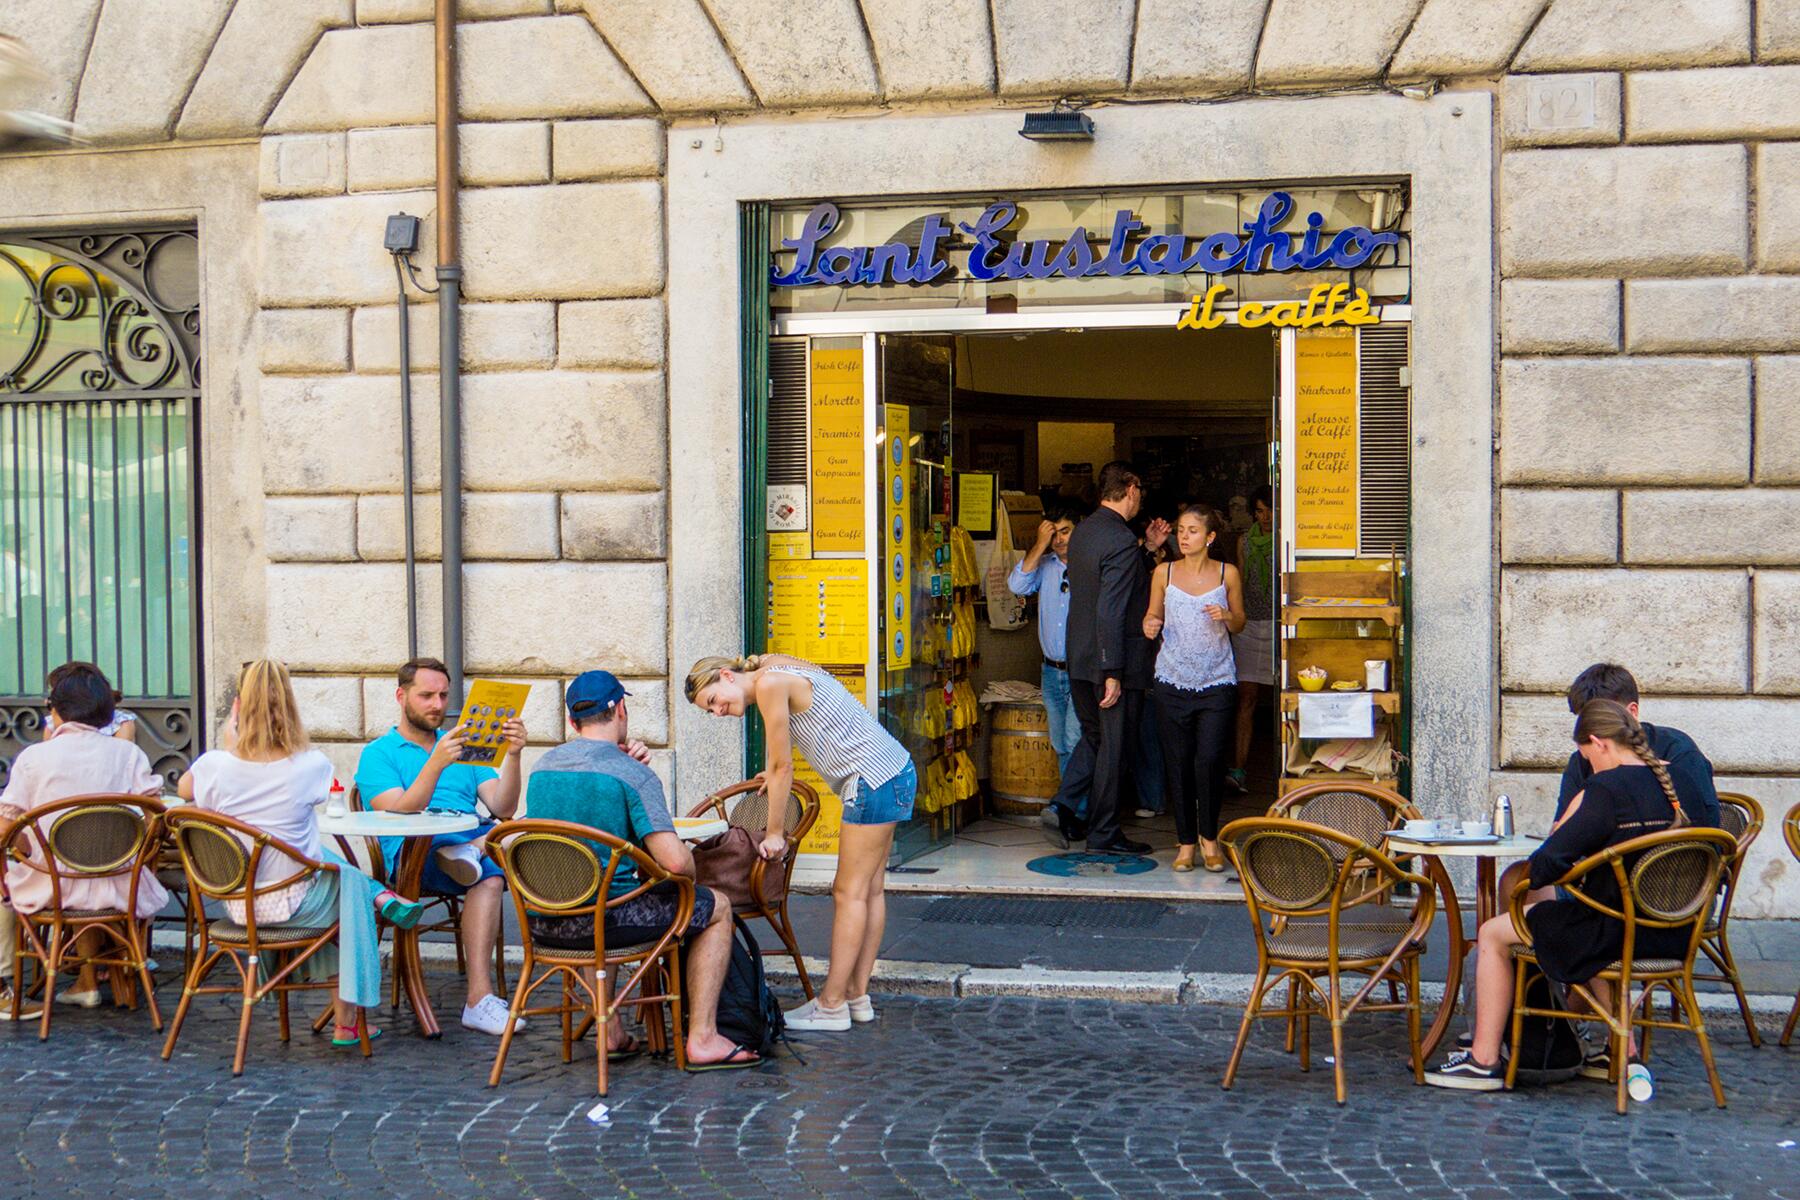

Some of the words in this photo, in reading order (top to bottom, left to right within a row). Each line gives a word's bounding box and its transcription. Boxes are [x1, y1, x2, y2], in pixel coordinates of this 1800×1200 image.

[769, 202, 951, 286] Sant
[958, 191, 1400, 281] Eustachio
[1176, 283, 1227, 330] il
[1238, 282, 1380, 328] caffè
[814, 393, 861, 406] Moretto
[1301, 412, 1350, 424] Mousse
[1300, 425, 1314, 436] al
[827, 455, 848, 465] Gran
[1300, 460, 1314, 471] al
[816, 529, 837, 538] Gran
